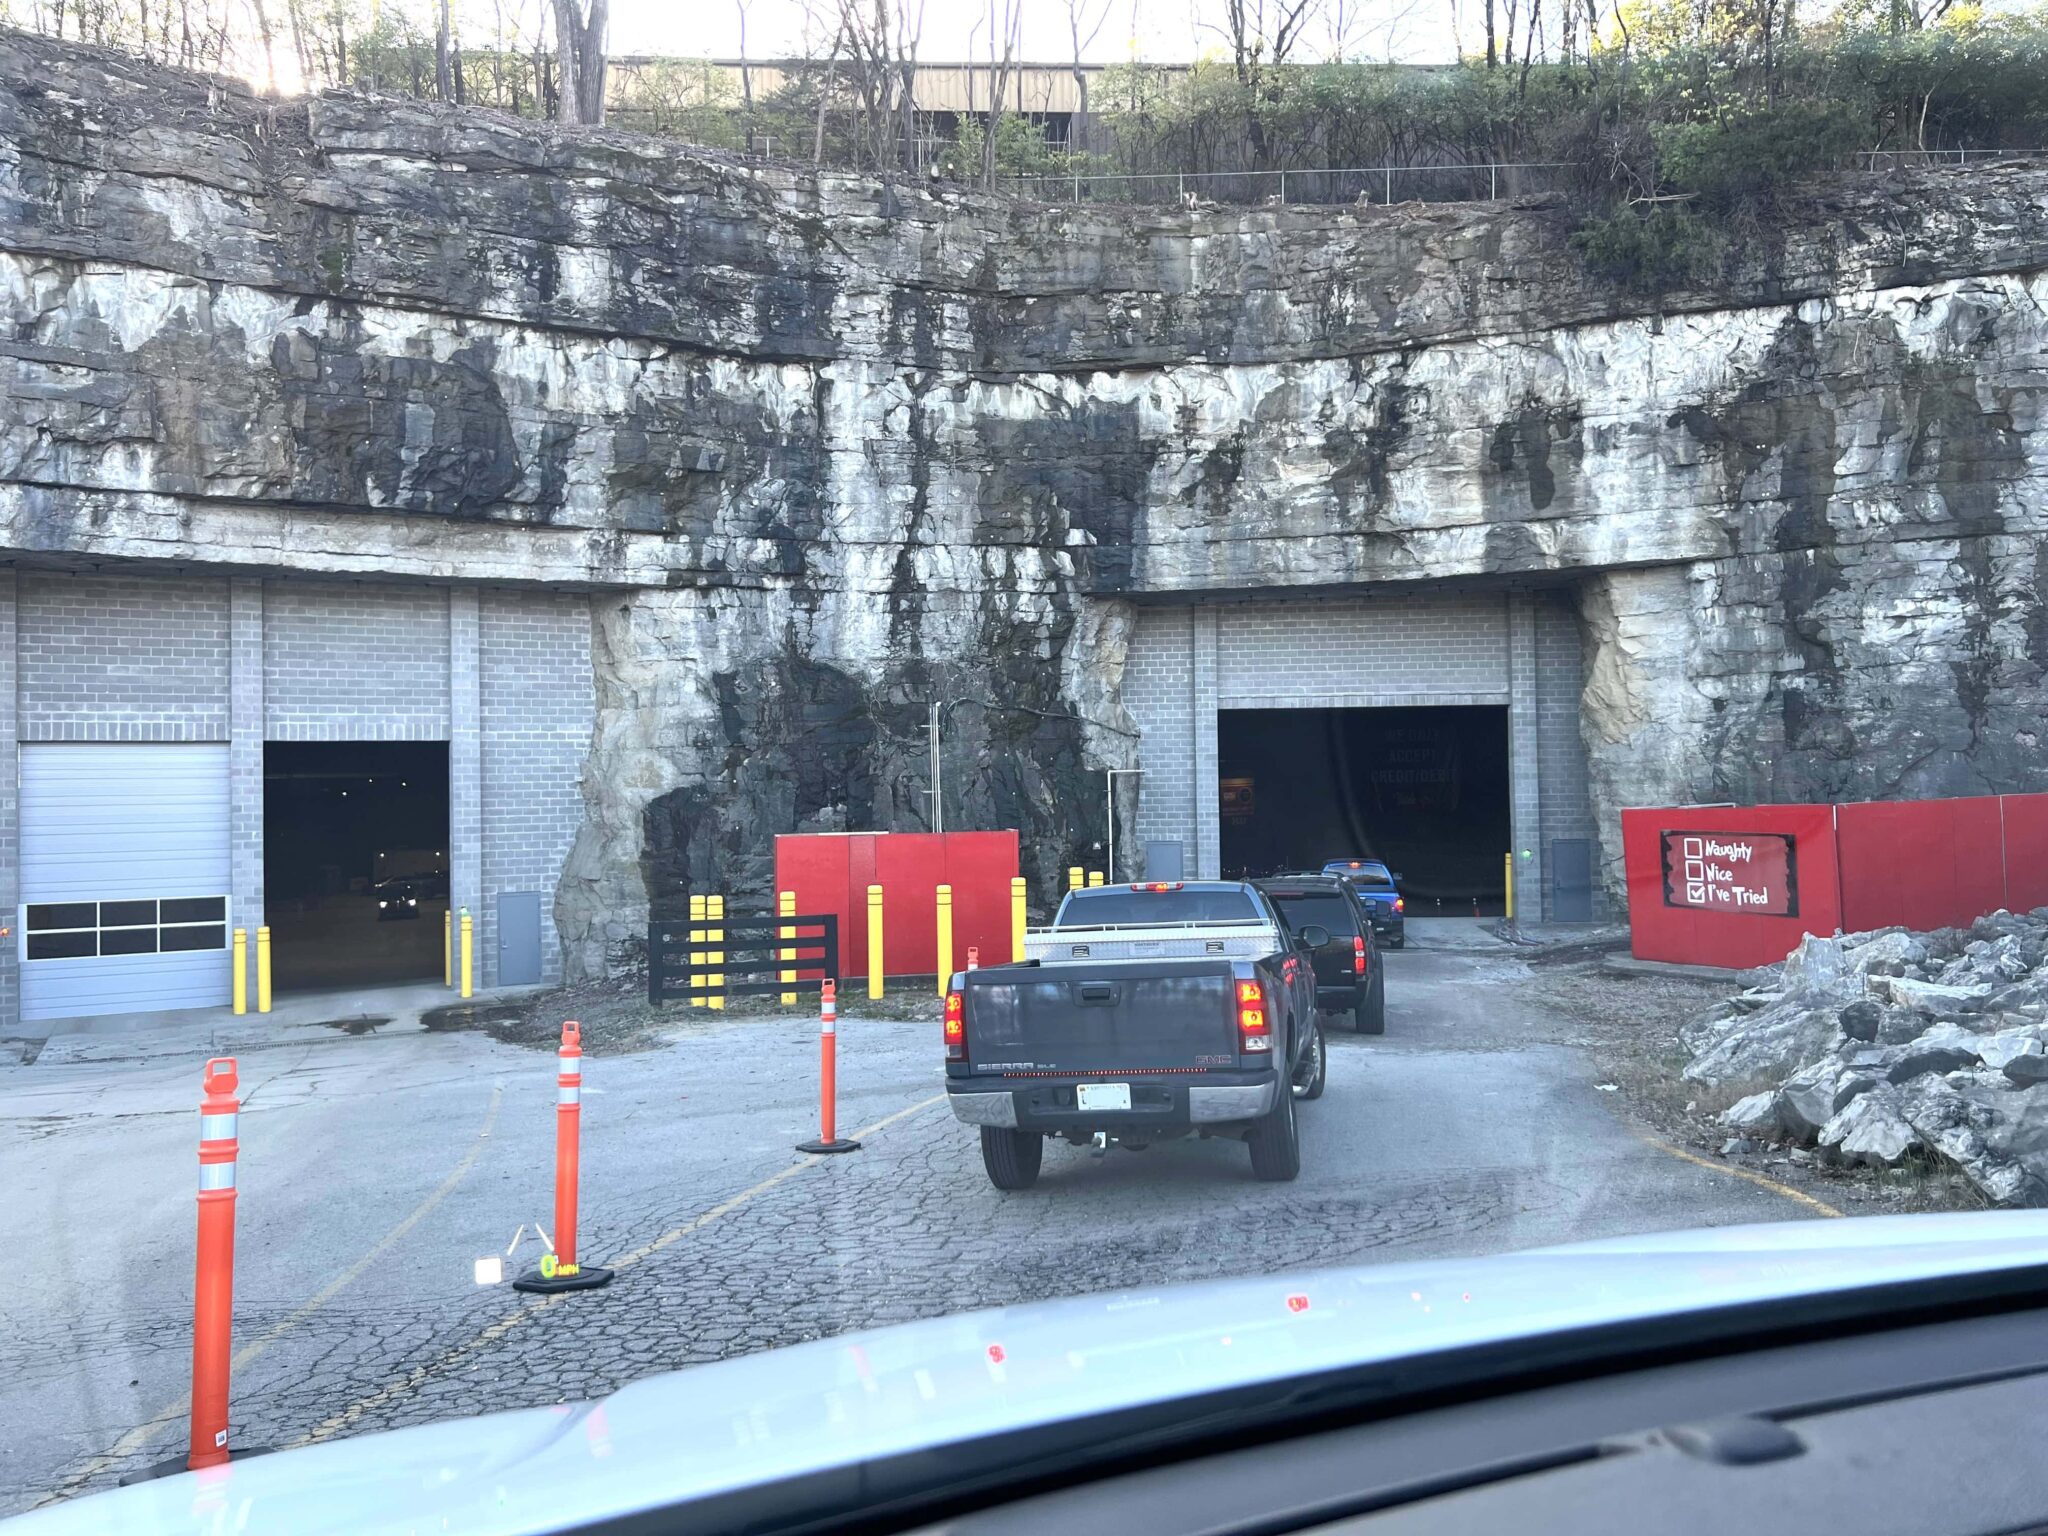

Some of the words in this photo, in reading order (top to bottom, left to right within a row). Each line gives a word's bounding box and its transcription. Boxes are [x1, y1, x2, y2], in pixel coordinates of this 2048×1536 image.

[1388, 749, 1437, 762] ACCEPT
[1705, 840, 1752, 862] Naughty
[1705, 862, 1733, 882] Nice
[1707, 884, 1730, 902] I've
[1731, 886, 1768, 906] Tried
[977, 1062, 1034, 1071] SIERRA
[1195, 1054, 1232, 1064] GMC
[541, 1254, 557, 1278] 0
[558, 1263, 580, 1276] MPH
